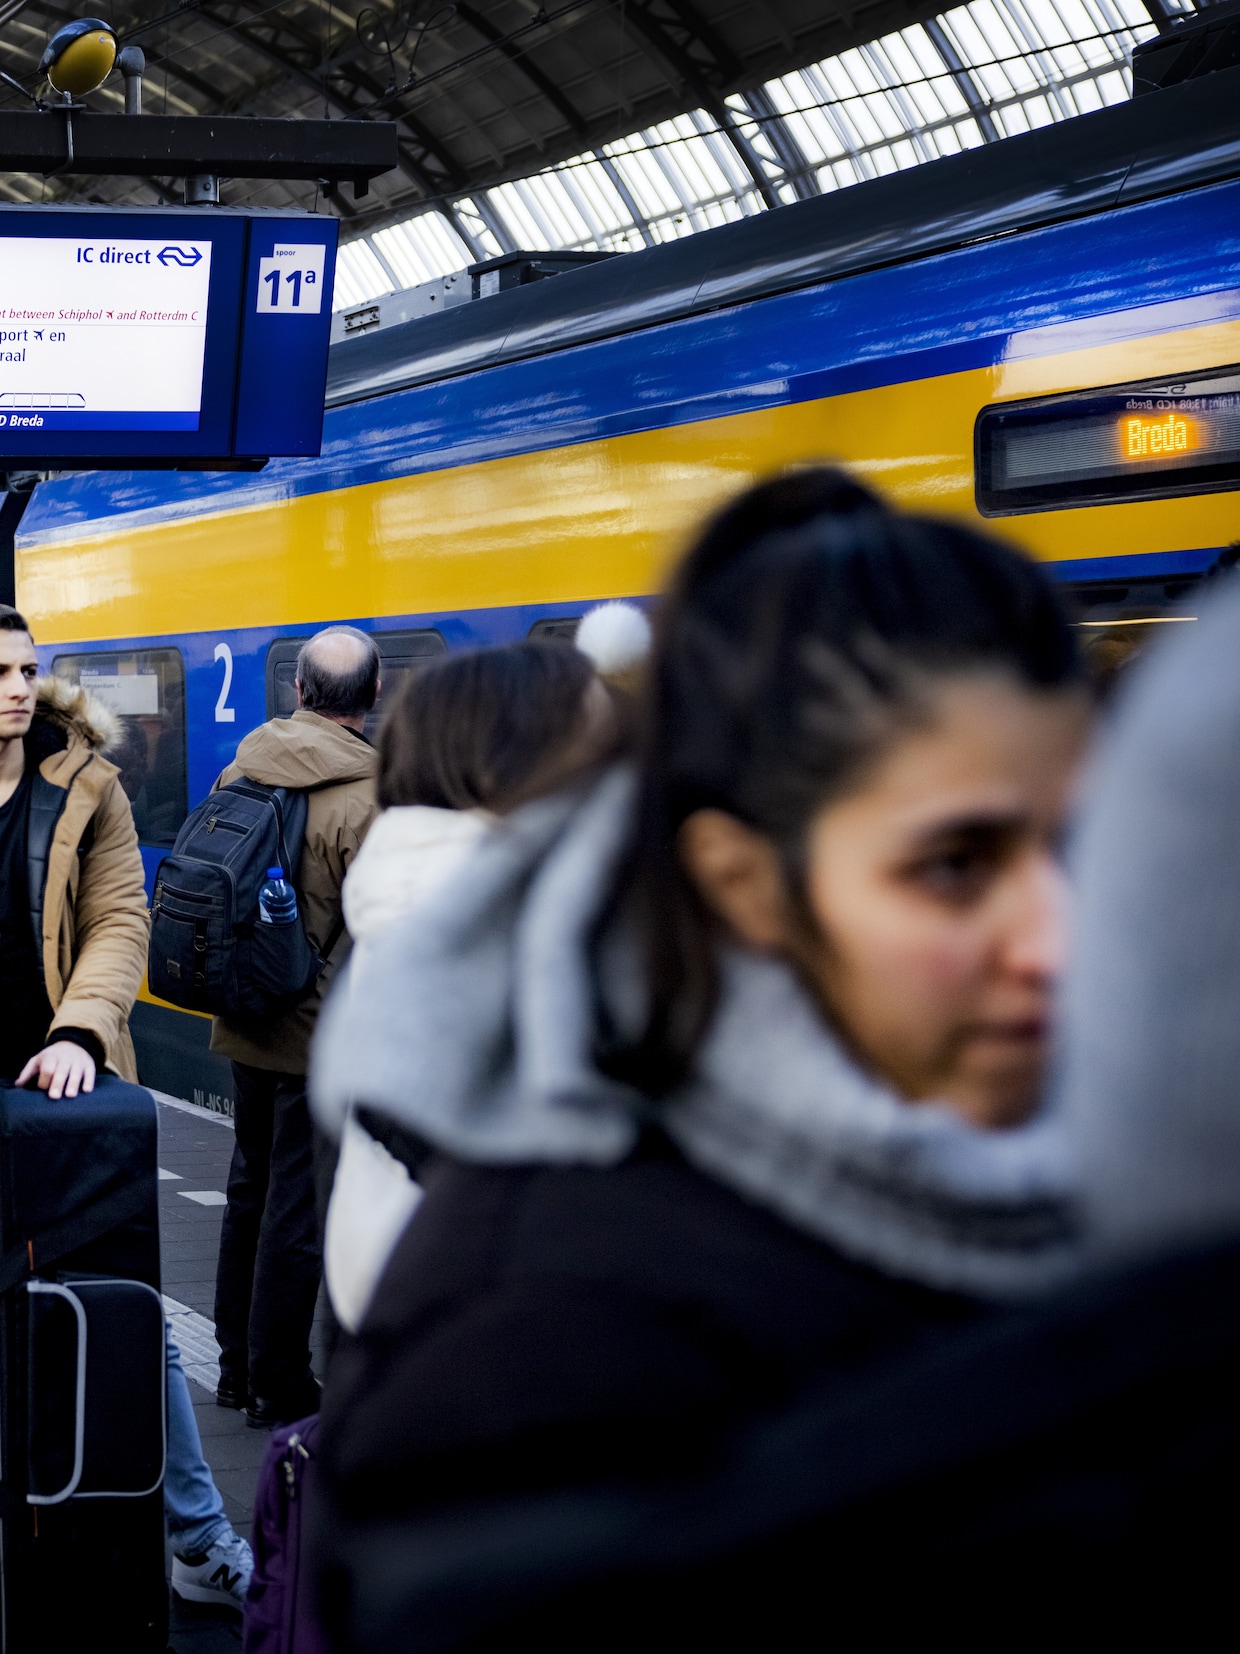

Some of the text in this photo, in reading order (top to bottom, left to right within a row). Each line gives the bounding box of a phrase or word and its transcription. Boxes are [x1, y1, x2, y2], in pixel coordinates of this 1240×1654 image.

[76, 246, 151, 264] IC direct
[9, 309, 55, 319] between
[58, 309, 103, 321] Schiphol
[117, 310, 137, 320] and
[139, 310, 188, 321] Rotterdm
[191, 310, 199, 321] C
[49, 331, 66, 342] en
[9, 414, 44, 427] Breda
[1128, 415, 1187, 456] Breda
[214, 642, 236, 723] 2
